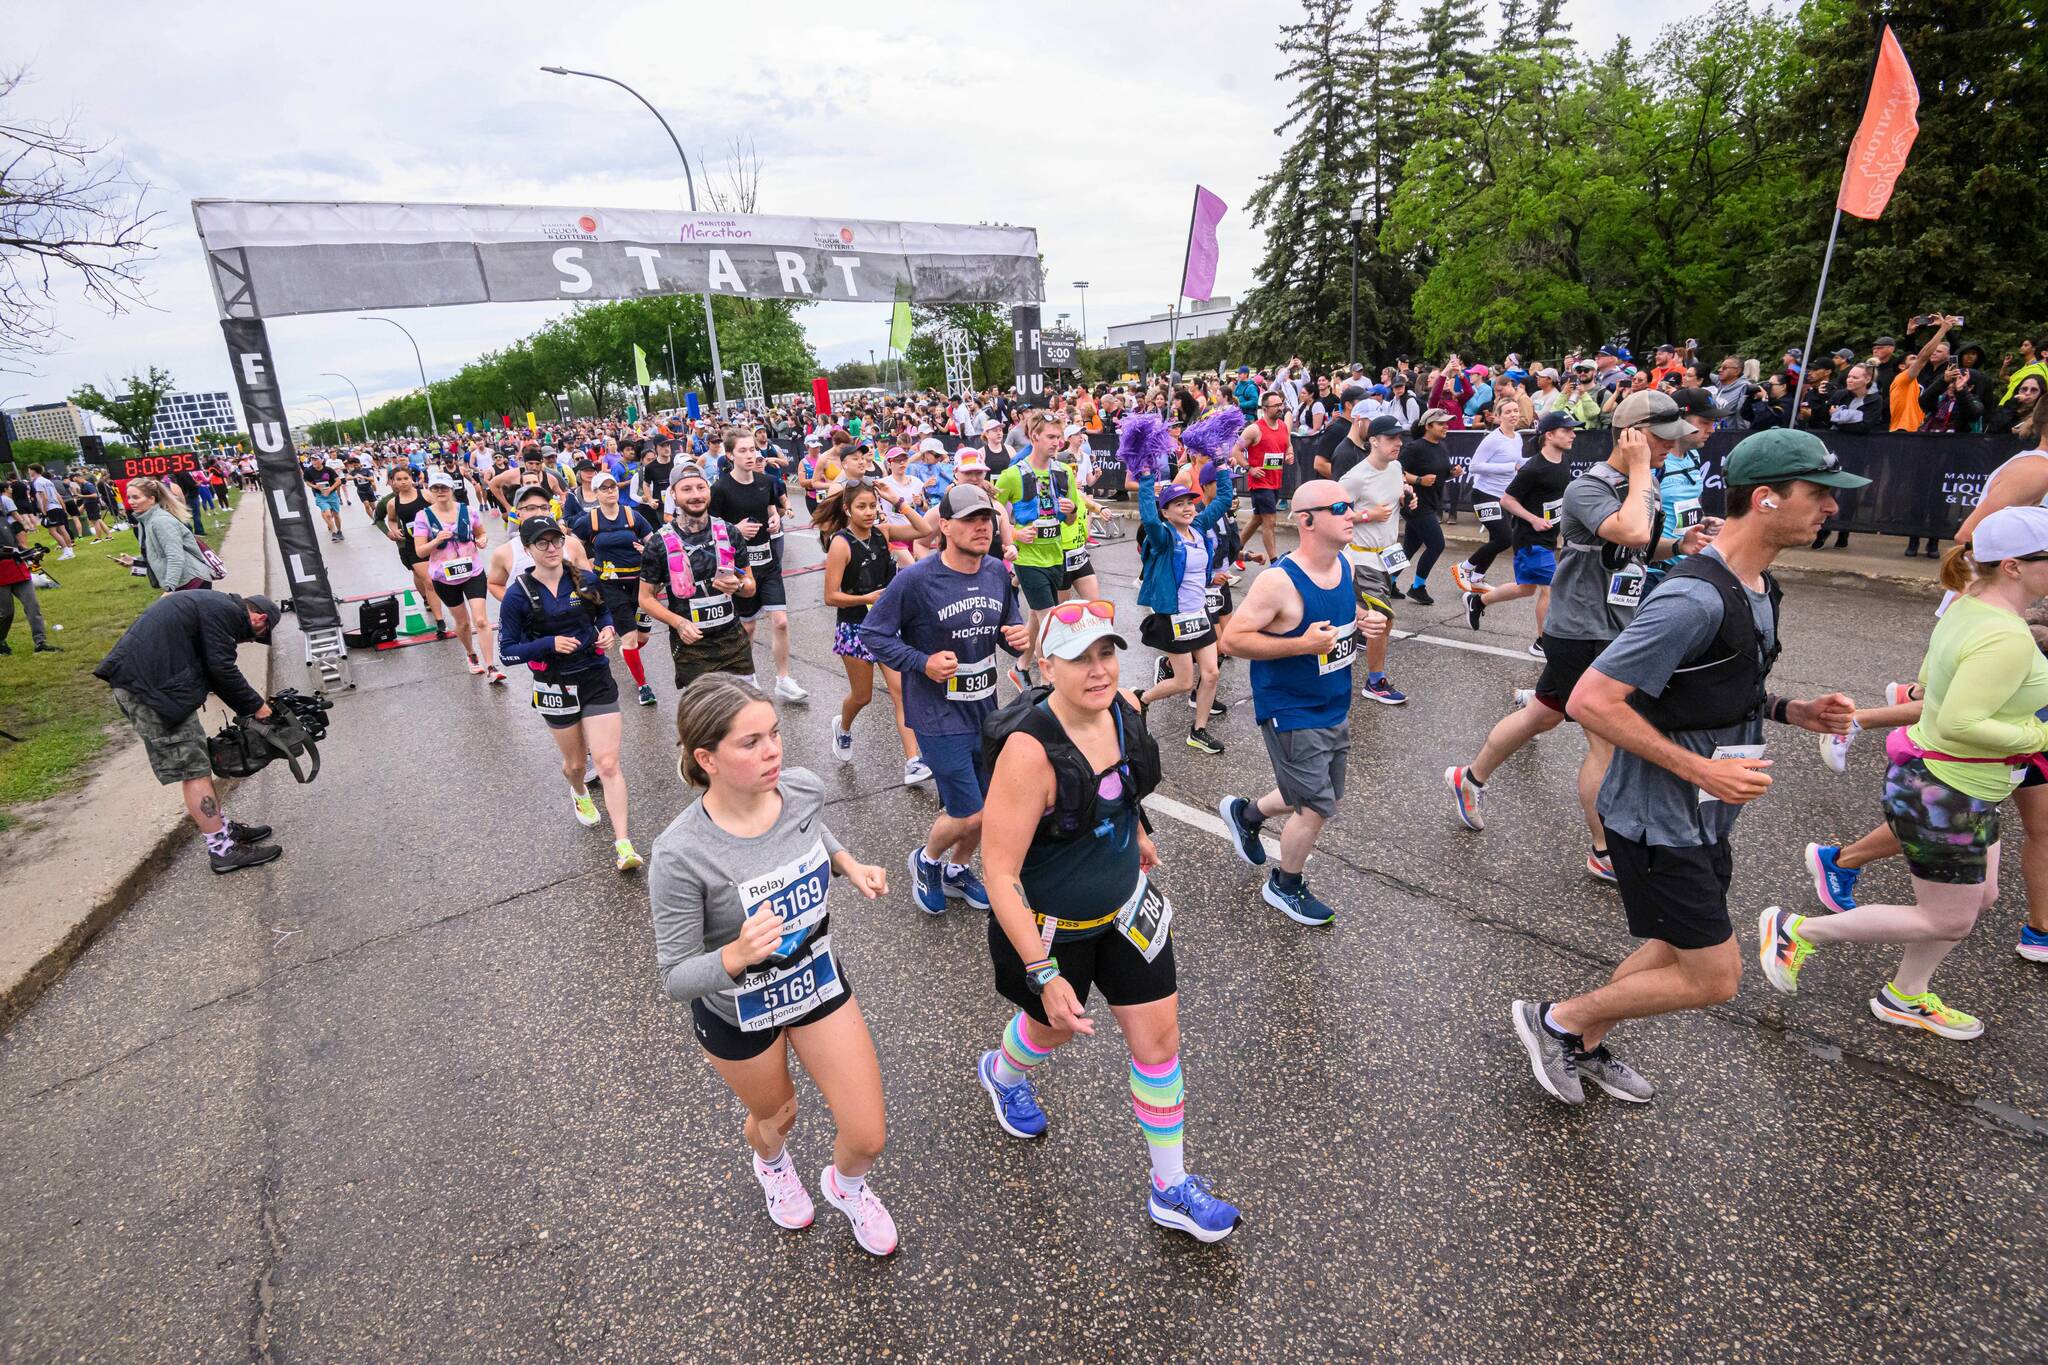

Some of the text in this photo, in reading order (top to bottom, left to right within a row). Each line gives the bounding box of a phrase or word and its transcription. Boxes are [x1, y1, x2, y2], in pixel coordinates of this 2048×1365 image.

[680, 223, 751, 242] Marathon
[552, 246, 861, 297] START
[1047, 347, 1070, 358] 5:00
[125, 454, 195, 477] 8:00:35
[240, 353, 316, 583] FULL
[1941, 482, 1982, 495] LIQU
[1945, 495, 1957, 504] &
[1480, 509, 1493, 517] 802
[1687, 510, 1698, 525] 114
[1043, 528, 1057, 538] 972
[748, 552, 763, 561] 955
[452, 564, 468, 575] 786
[704, 605, 725, 621] 709
[938, 596, 987, 622] WINNIPEG
[951, 625, 998, 639] HOCKEY
[1185, 620, 1200, 633] 514
[1334, 637, 1354, 659] 397
[965, 673, 988, 692] 930
[542, 694, 563, 708] 409
[749, 876, 785, 899] Relay
[772, 875, 823, 922] 5169
[1138, 888, 1163, 929] 784
[743, 969, 778, 990] Relay
[763, 968, 815, 1009] 5169
[748, 1003, 803, 1031] Transponder
